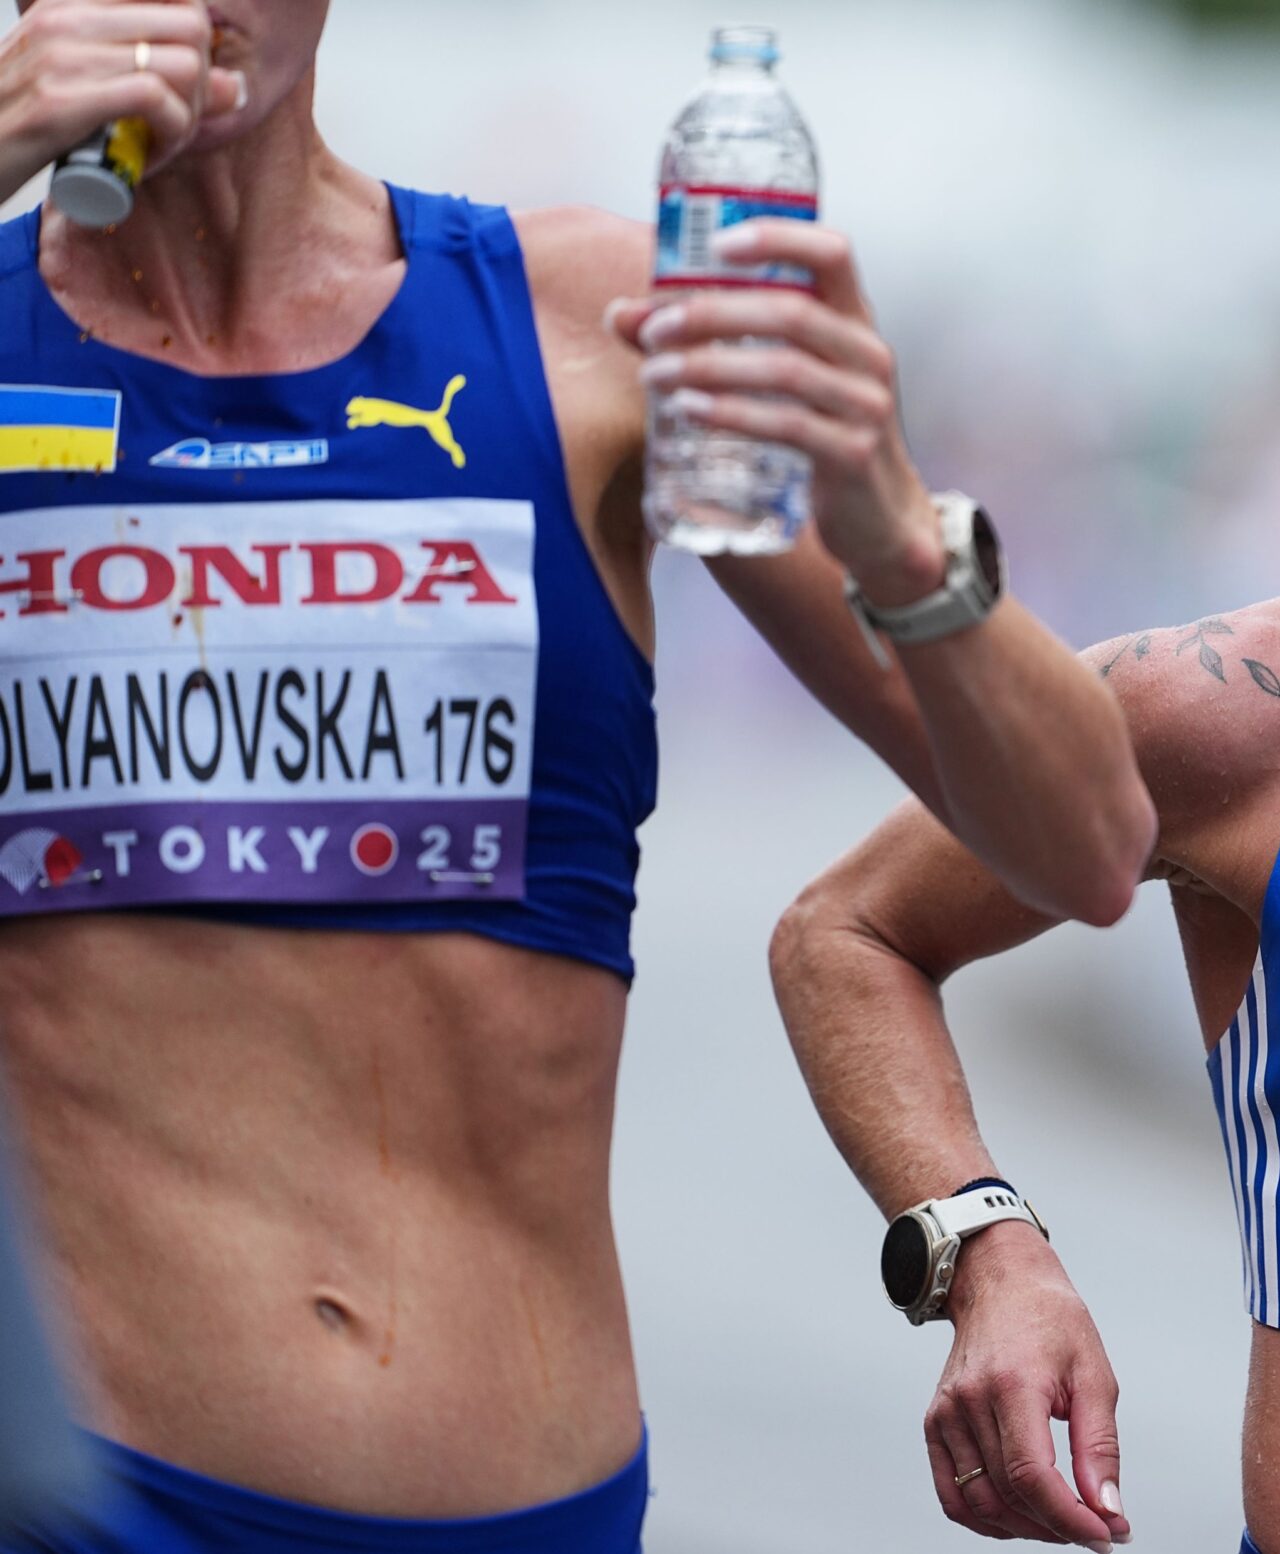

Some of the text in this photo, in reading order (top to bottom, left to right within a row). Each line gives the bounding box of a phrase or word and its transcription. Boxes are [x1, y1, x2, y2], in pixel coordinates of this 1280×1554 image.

[0, 540, 517, 618] HONDA
[0, 668, 516, 799] LYANOVSKA 176
[416, 824, 501, 872] 25
